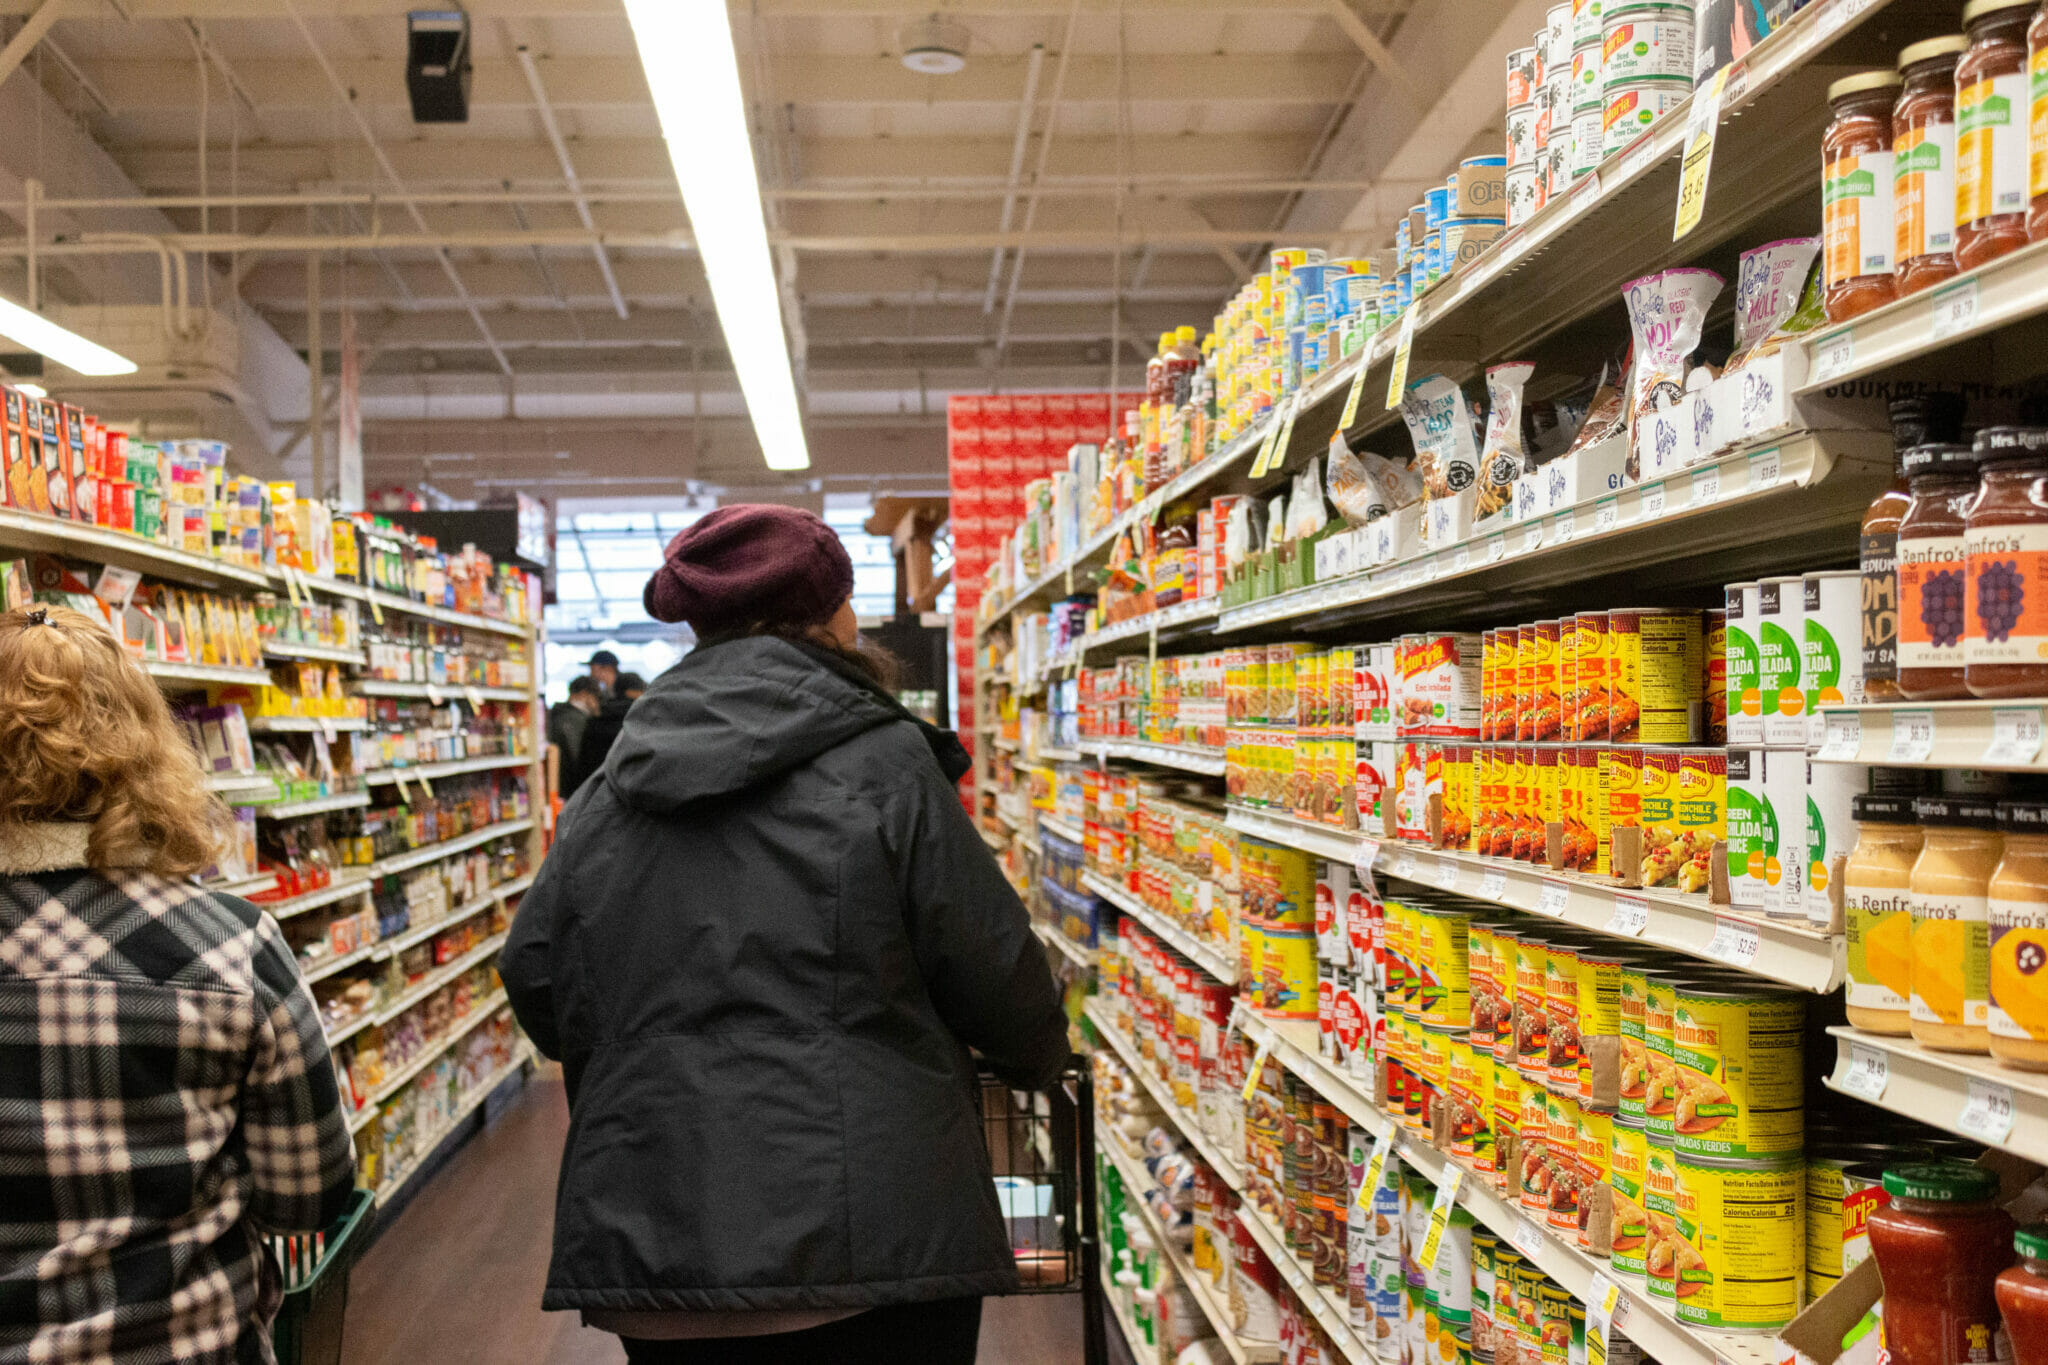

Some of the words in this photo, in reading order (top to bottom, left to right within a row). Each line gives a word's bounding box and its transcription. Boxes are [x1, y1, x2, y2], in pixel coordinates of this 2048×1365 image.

[1620, 119, 1633, 128] Diced
[1772, 271, 1784, 285] RED
[1669, 300, 1686, 315] RED
[1747, 289, 1779, 324] MOLE
[1641, 644, 1669, 652] Calories
[1677, 643, 1687, 651] 20
[1728, 646, 1745, 658] EEN
[1761, 644, 1782, 656] EEN
[1804, 642, 1822, 654] EEN
[1439, 674, 1451, 683] Red
[1689, 772, 1707, 787] PASO
[1862, 895, 1909, 916] Renfr
[1911, 903, 1958, 920] enfro's
[1702, 1140, 1731, 1153] VERDES
[1723, 1178, 1744, 1188] Nutrition
[1905, 1186, 1951, 1199] MILD
[1784, 1204, 1796, 1215] 25
